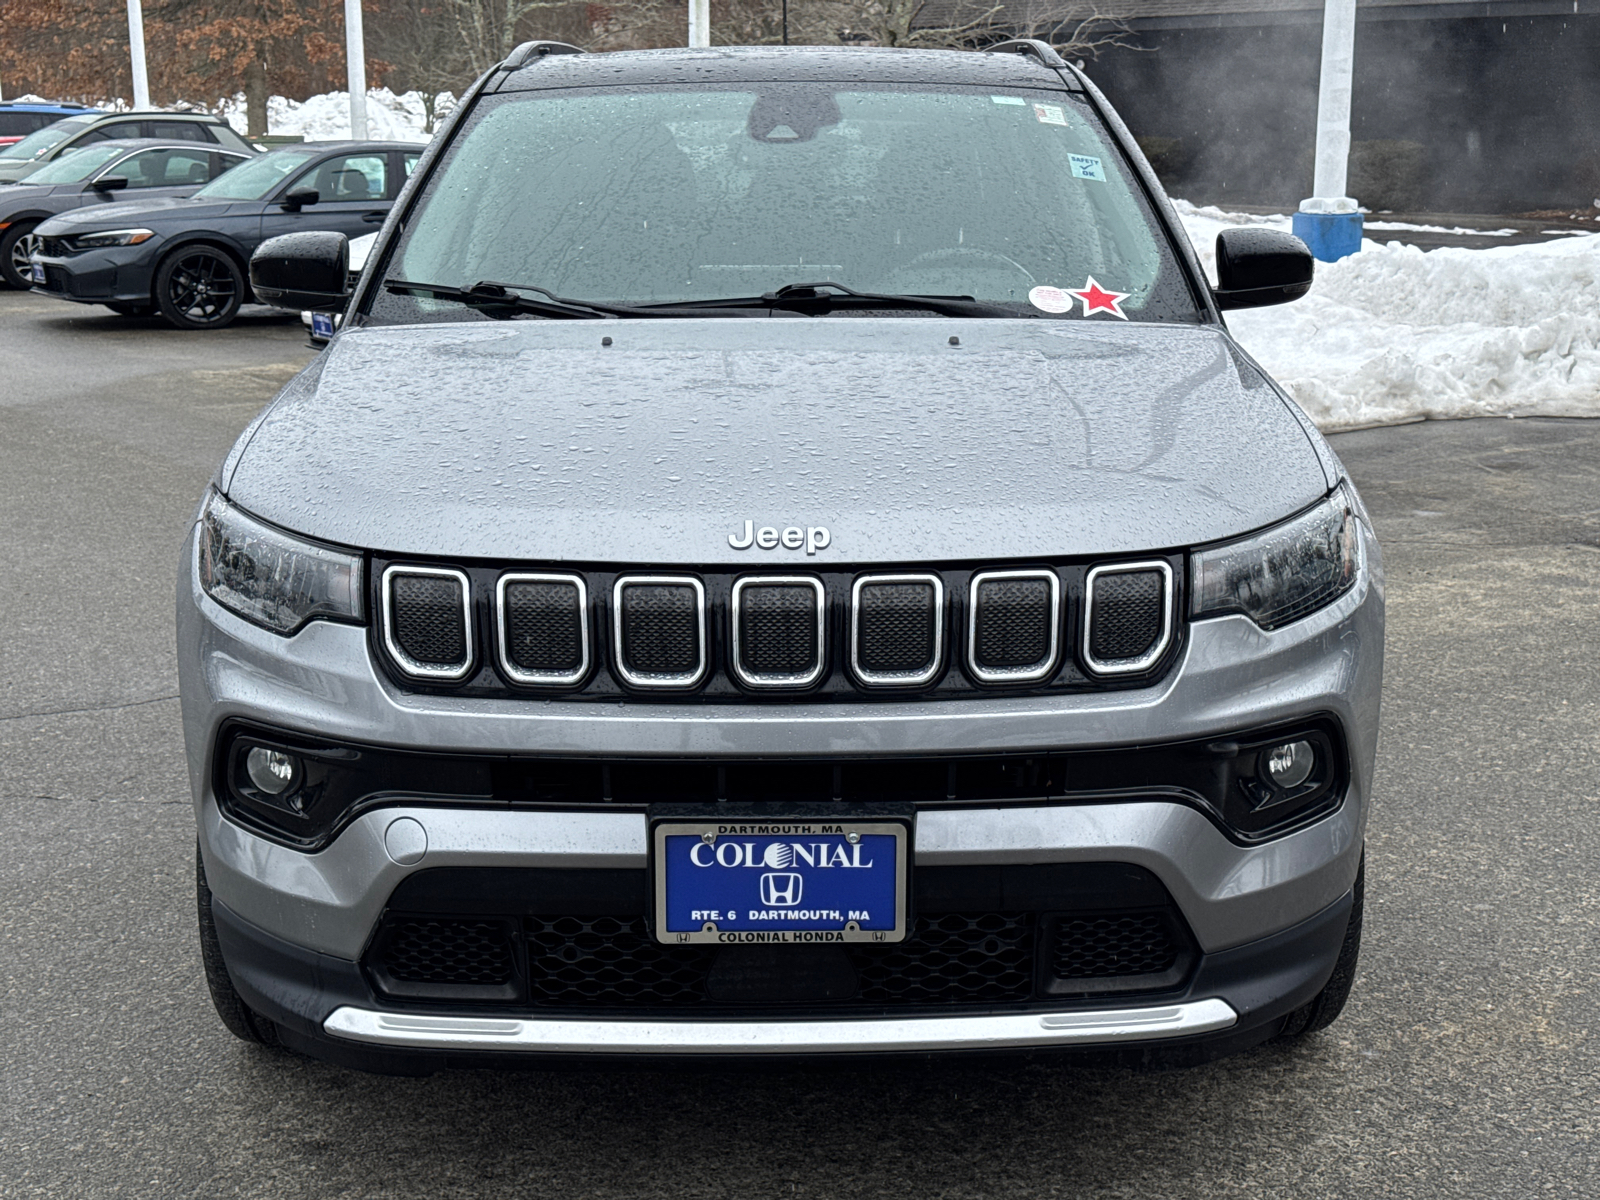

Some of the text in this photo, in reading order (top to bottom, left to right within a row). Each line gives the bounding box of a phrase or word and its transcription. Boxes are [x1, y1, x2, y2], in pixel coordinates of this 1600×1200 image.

[1070, 156, 1099, 165] SAFETY
[728, 519, 831, 556] Jeep
[718, 825, 844, 834] DARTMOUTH, MA
[690, 842, 873, 869] COLONIAL
[691, 910, 870, 922] RTE. 6 DARTMOUTH, MA
[718, 931, 845, 943] COLONIAL HONDA
